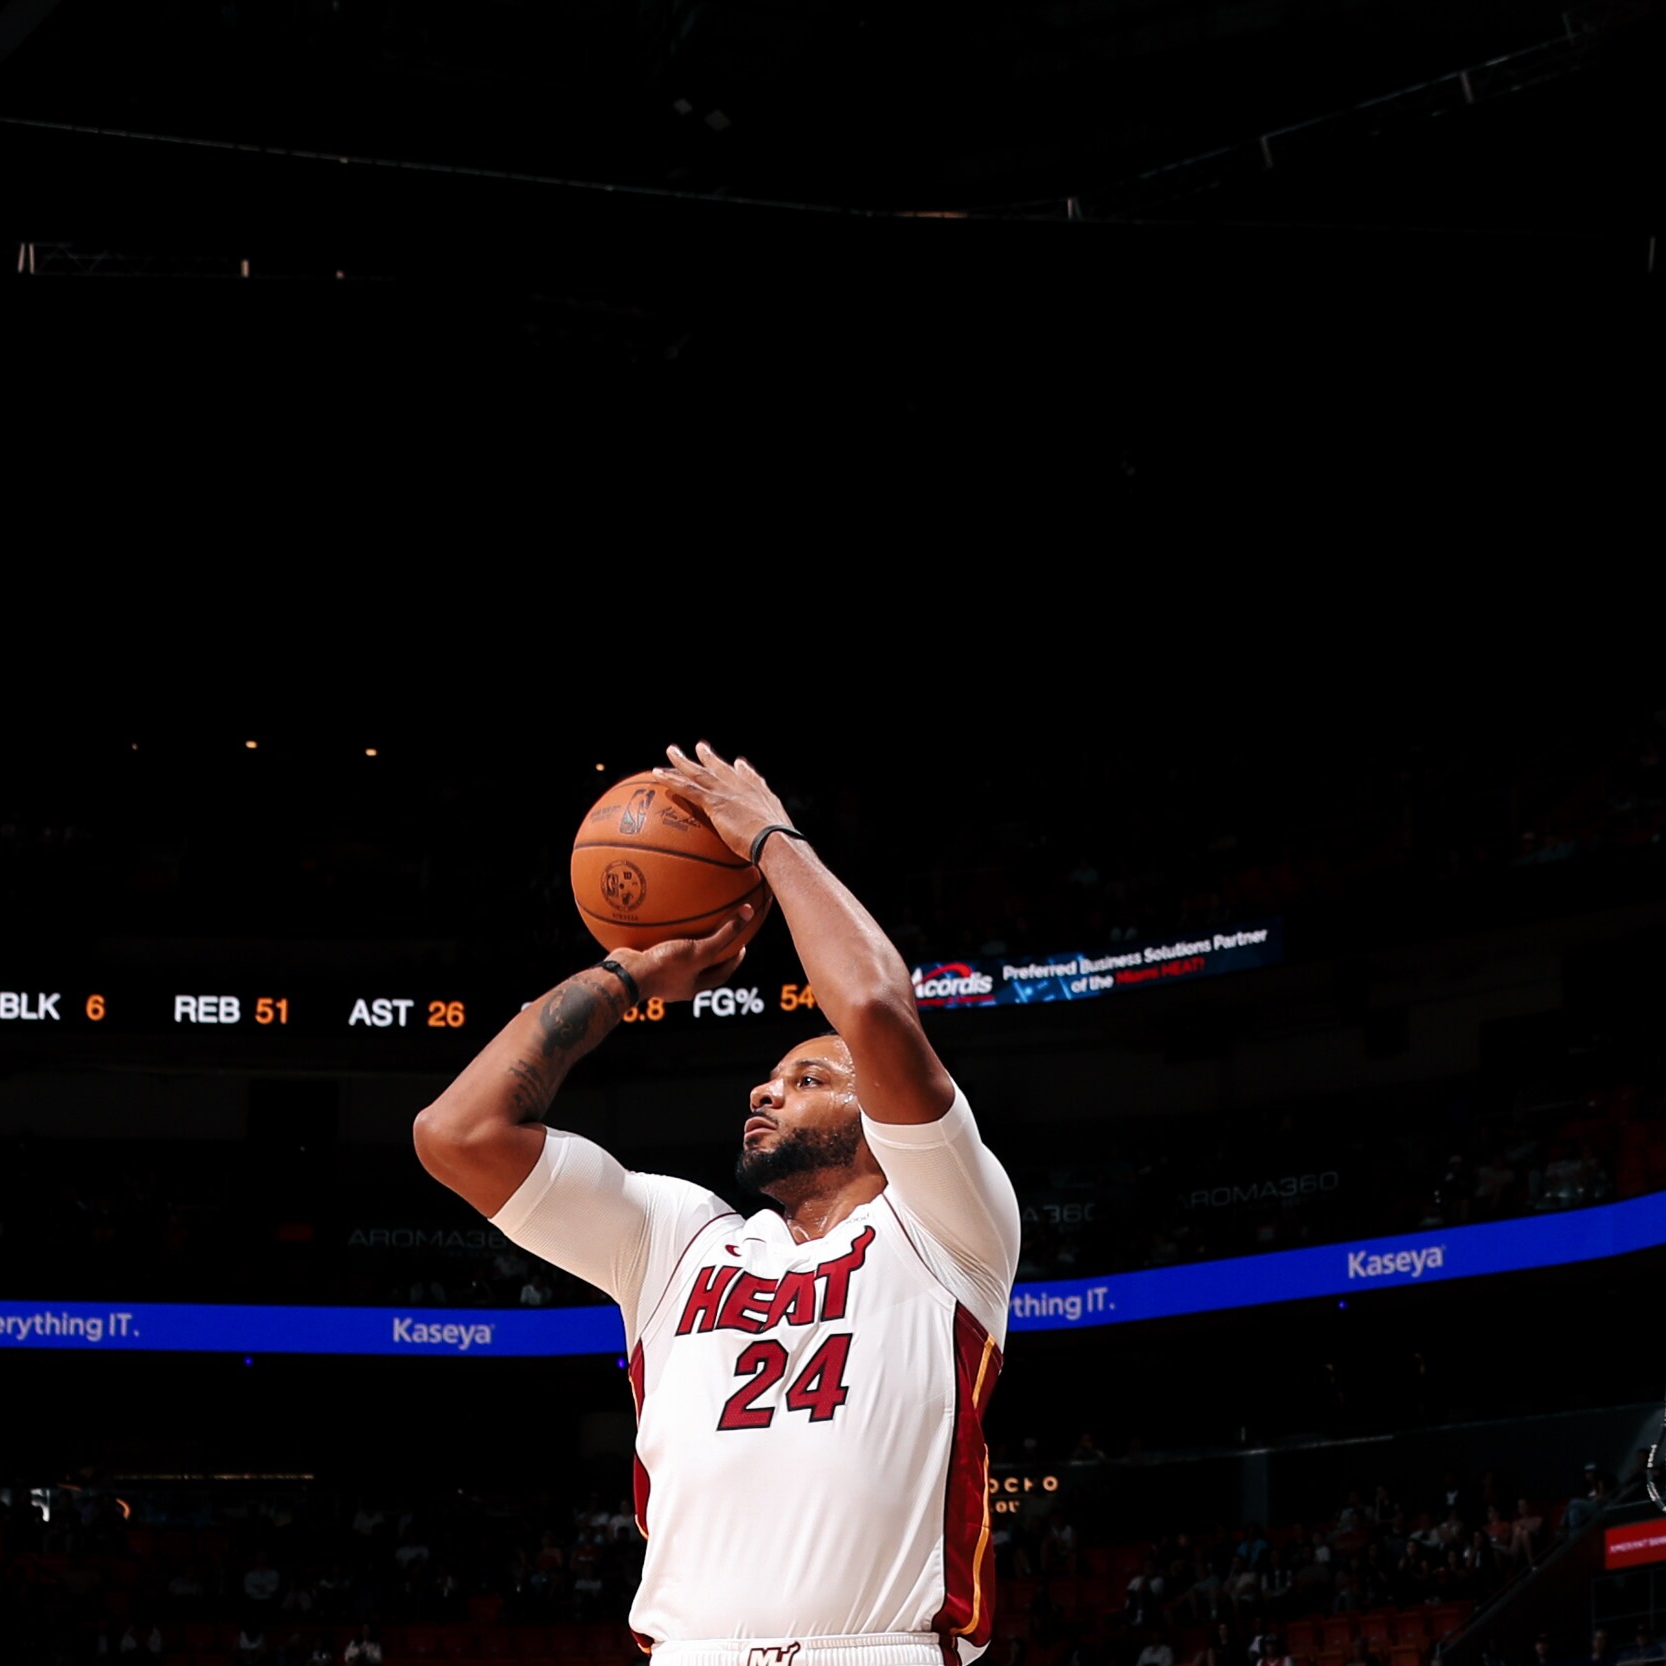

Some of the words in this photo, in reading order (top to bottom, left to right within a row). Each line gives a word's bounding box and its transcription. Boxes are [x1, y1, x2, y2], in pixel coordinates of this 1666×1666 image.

[1002, 960, 1078, 982] Preferred
[1079, 951, 1143, 976] Business
[1143, 938, 1213, 964] Solutions
[1213, 928, 1269, 952] Partner
[1070, 978, 1087, 994] of
[1088, 974, 1115, 992] the
[85, 993, 106, 1022] 6
[173, 994, 241, 1025] REB
[254, 997, 290, 1026] 51
[347, 998, 415, 1028] AST
[427, 1000, 466, 1028] 26
[692, 987, 766, 1020] FG%
[347, 1228, 510, 1249] AROMA36
[1347, 1246, 1446, 1280] Kaseya
[675, 1225, 877, 1337] HEAT
[1086, 1287, 1116, 1314] IT.
[108, 1312, 141, 1338] IT.
[393, 1317, 494, 1352] Kaseya
[716, 1332, 854, 1431] 24
